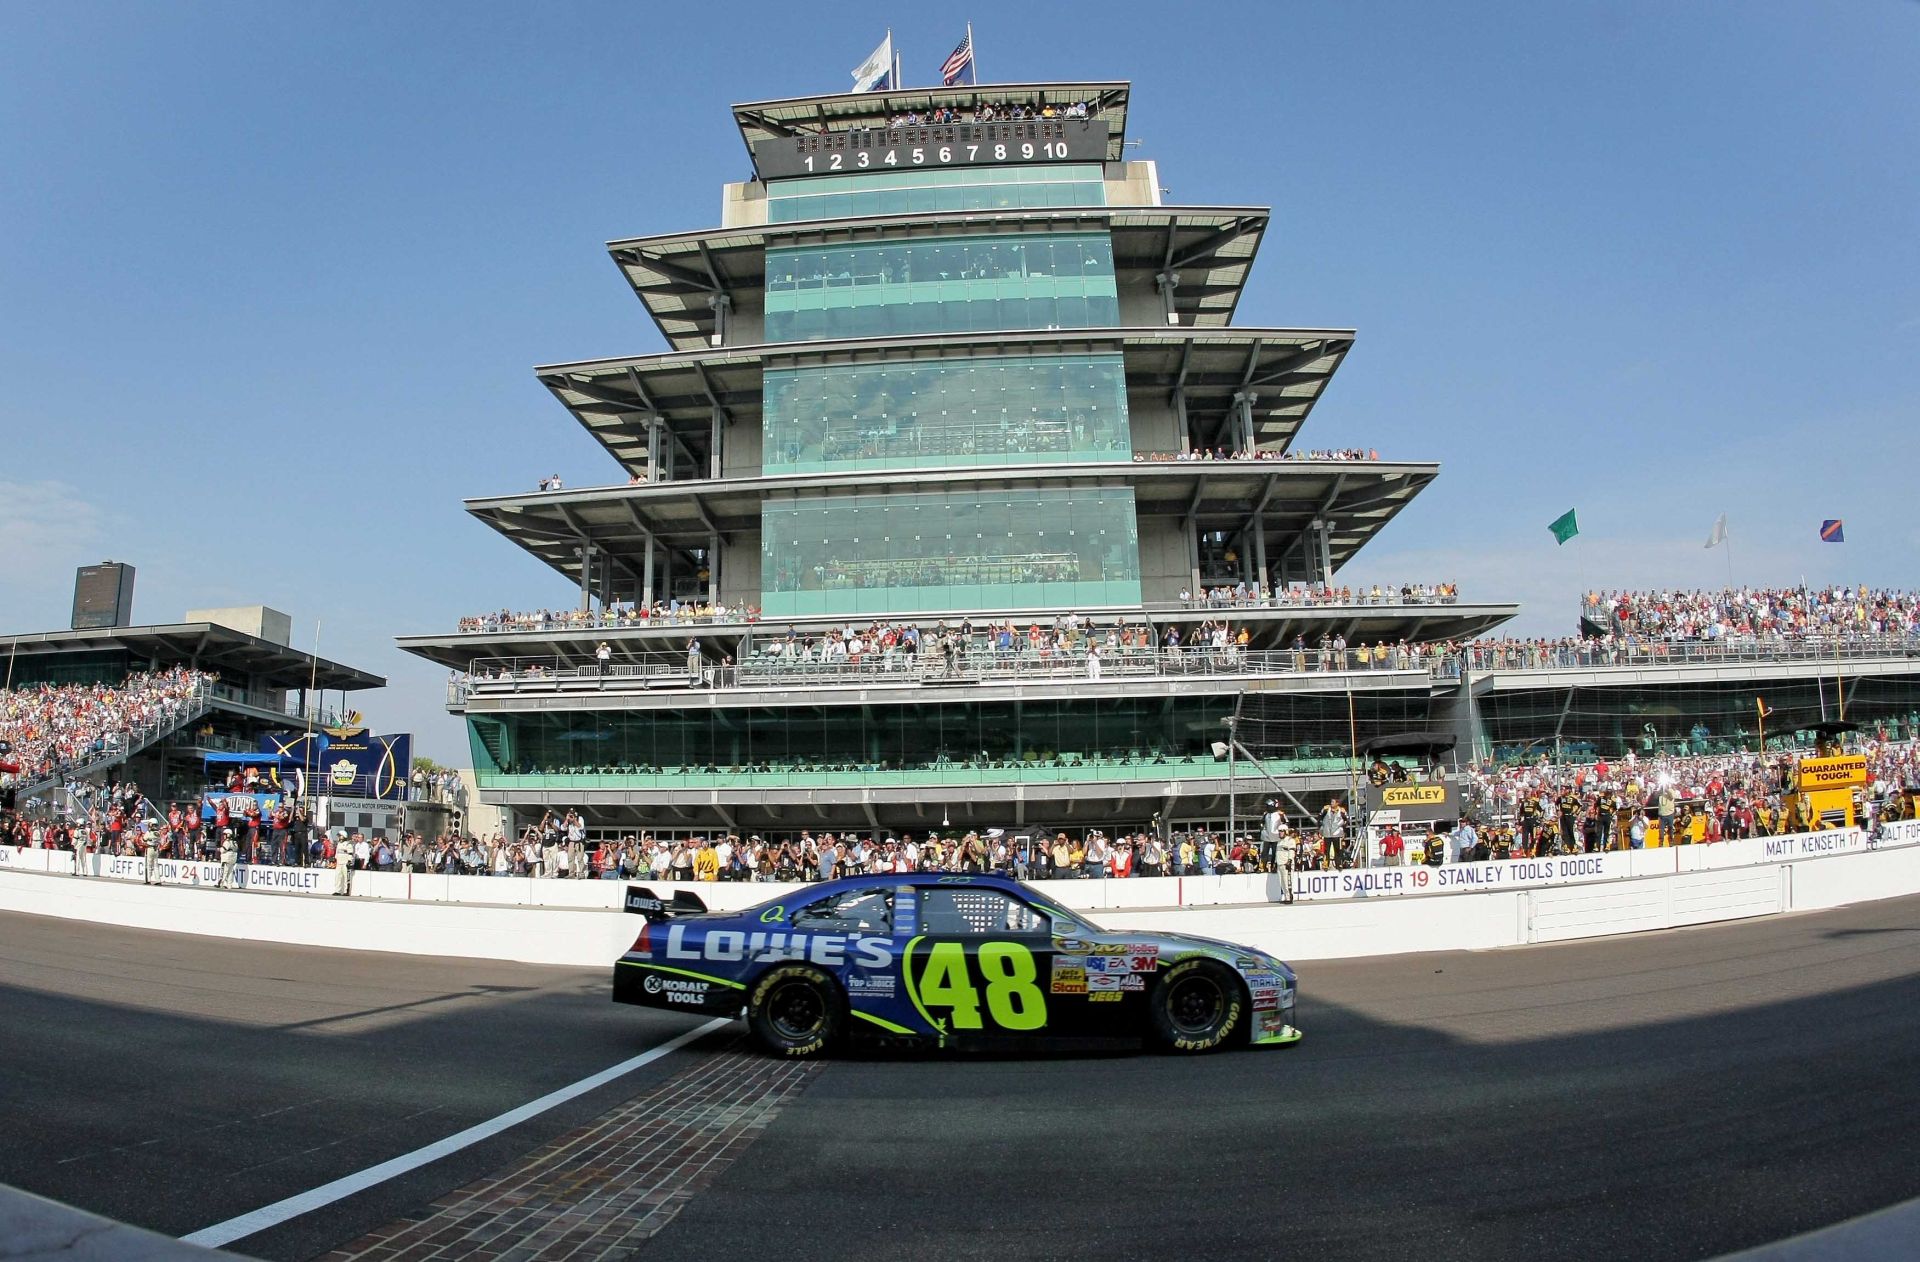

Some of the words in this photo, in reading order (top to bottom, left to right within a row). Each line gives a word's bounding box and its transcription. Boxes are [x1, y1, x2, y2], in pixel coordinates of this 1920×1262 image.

[804, 156, 813, 172] 1
[829, 153, 843, 170] 2
[857, 151, 870, 168] 3
[884, 149, 897, 166] 4
[912, 148, 924, 164] 5
[939, 146, 952, 163] 6
[966, 145, 979, 161] 7
[994, 144, 1007, 160] 8
[1021, 143, 1034, 159] 9
[1043, 142, 1068, 158] 10
[1801, 761, 1866, 774] GUARANTEED
[1815, 772, 1853, 781] TOUGH.
[1387, 790, 1440, 801] STANLEY
[1766, 839, 1795, 856] MATT
[1801, 833, 1846, 853] KENSETH
[1848, 831, 1860, 846] 17
[110, 860, 133, 874] JEFF
[138, 862, 177, 878] GDON
[181, 865, 198, 880] 24
[204, 866, 246, 883] DUPNT
[251, 869, 320, 889] CHEVROLET
[1343, 872, 1403, 892] SADLER
[1409, 871, 1429, 887] 19
[1438, 865, 1503, 886] STANLEY
[1510, 862, 1553, 881] TOOLS
[1560, 858, 1603, 877] DODGE
[666, 924, 894, 968] LOWE'S
[1086, 957, 1106, 971] USG
[1108, 958, 1127, 968] EA
[1130, 957, 1157, 971] 3M
[662, 979, 710, 993] KOBALT
[919, 941, 1048, 1030] 48
[1120, 975, 1145, 986] MAC
[1251, 978, 1280, 988] MAHLE
[666, 992, 705, 1004] TOOLS
[1174, 1002, 1240, 1050] GOODYEAR
[786, 1038, 823, 1055] EAGLE
